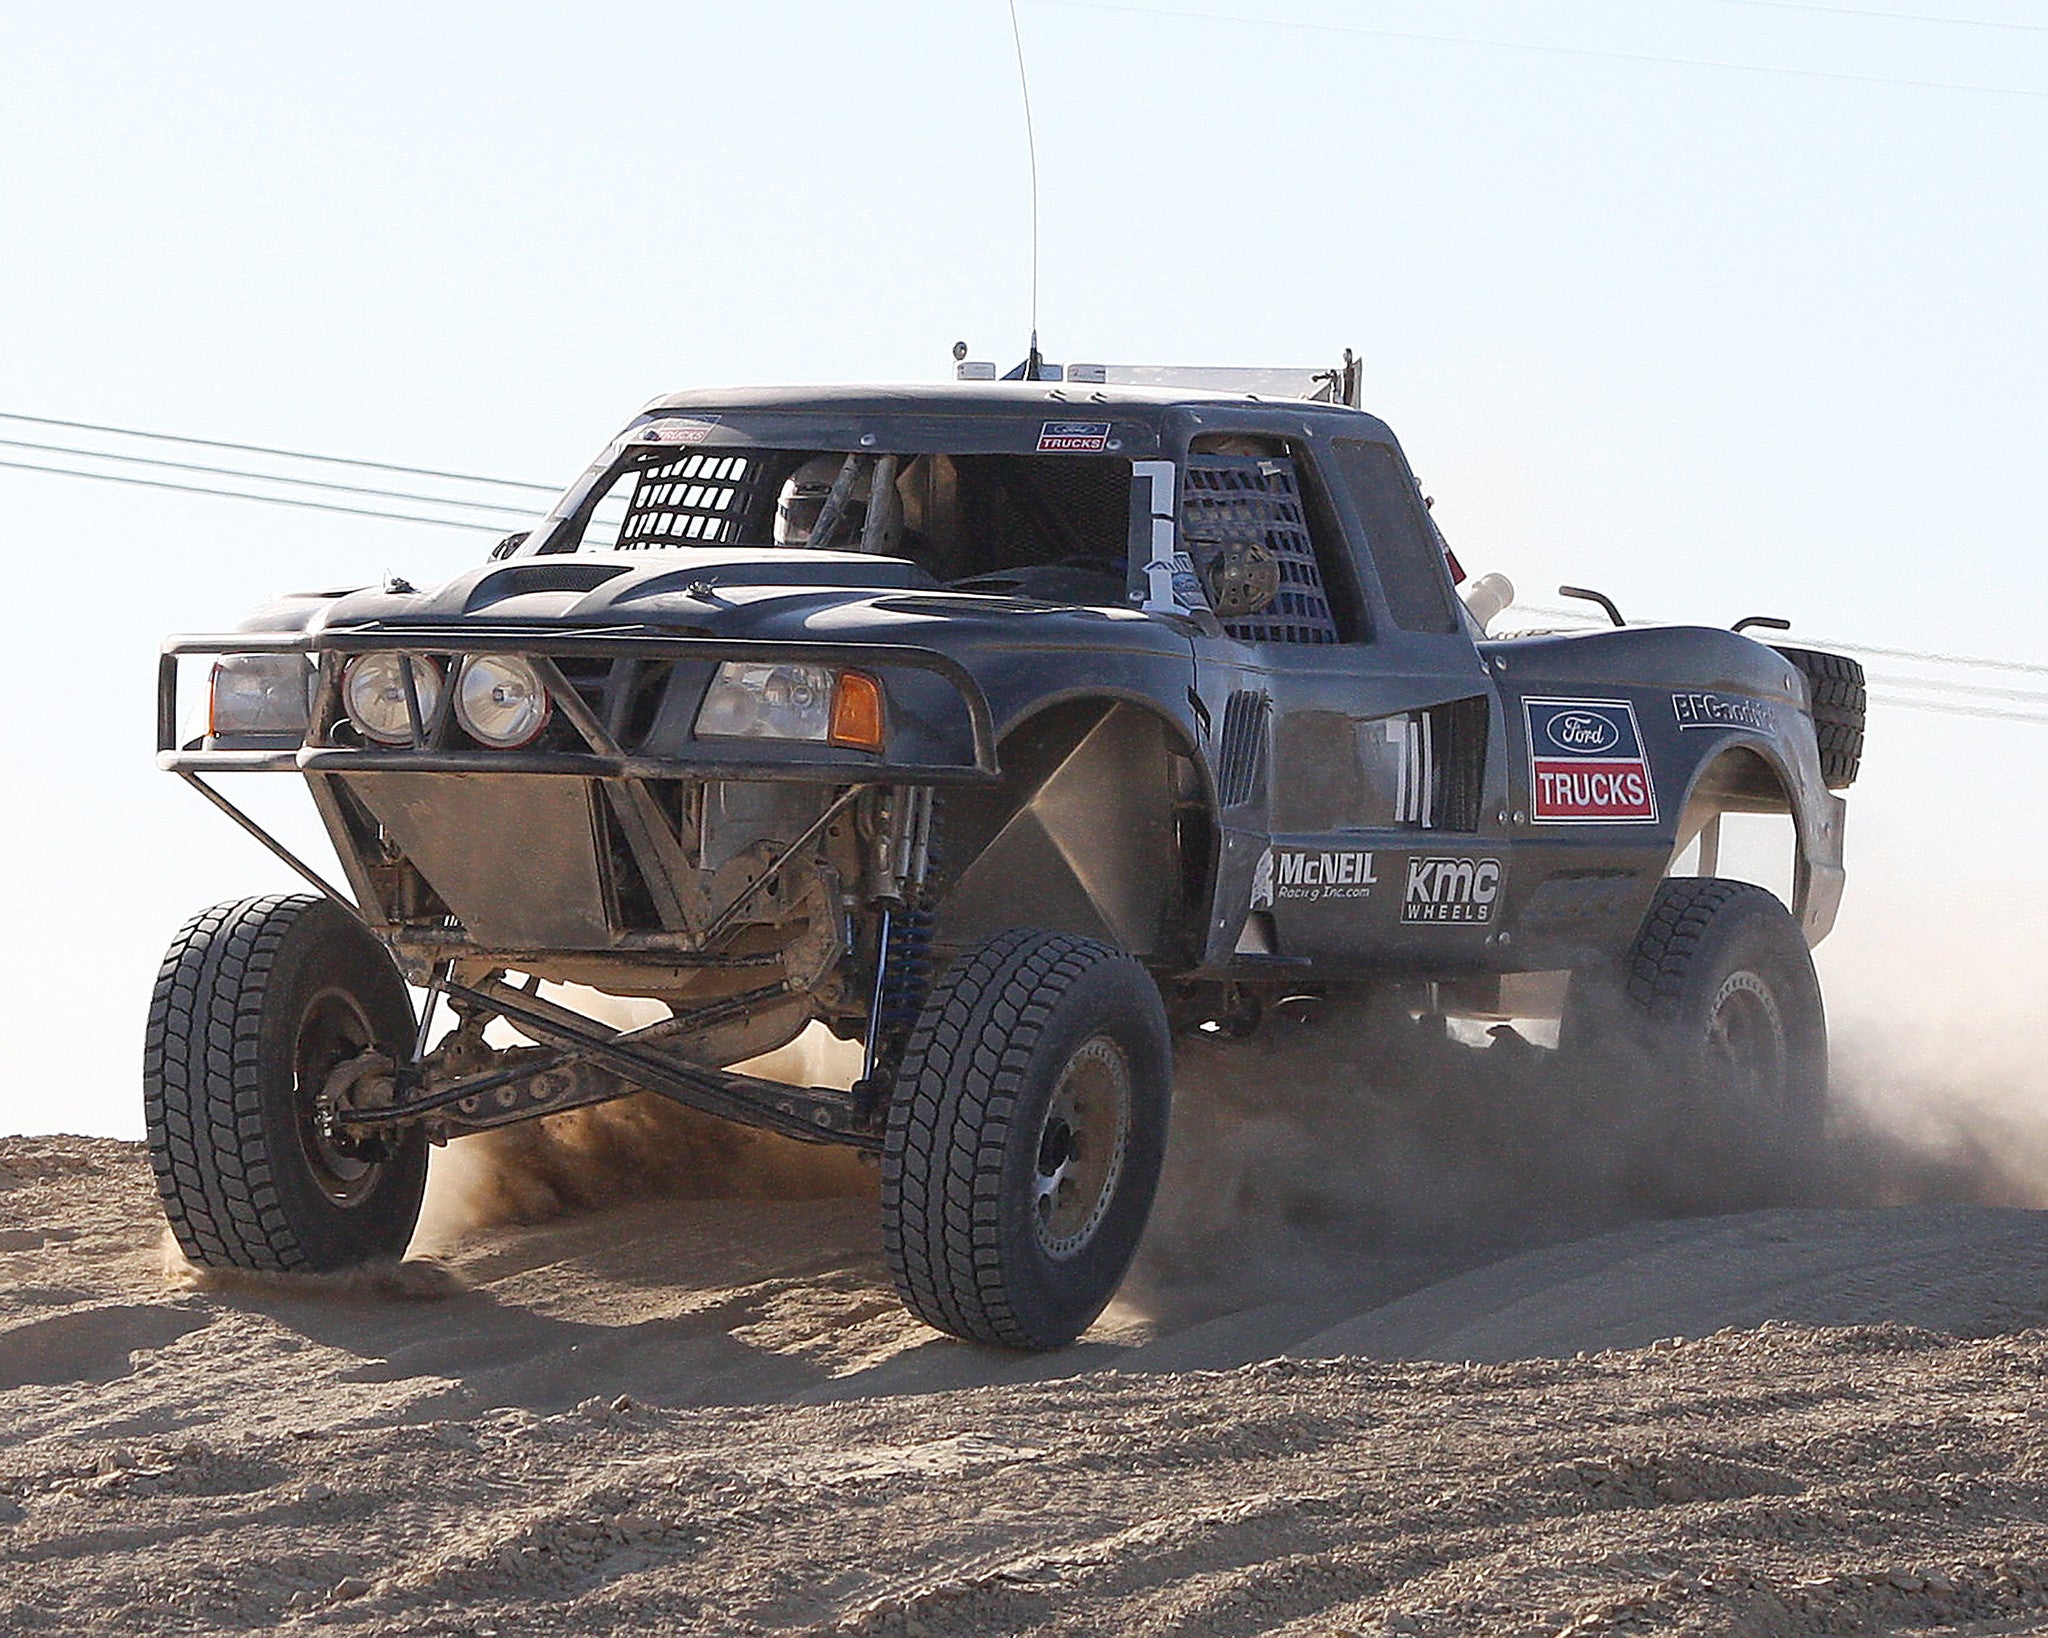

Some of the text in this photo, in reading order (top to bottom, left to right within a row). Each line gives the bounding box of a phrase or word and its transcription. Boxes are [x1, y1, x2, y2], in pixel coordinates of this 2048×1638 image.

[1043, 438, 1101, 449] TRUCKS
[1561, 716, 1605, 744] Ford
[1539, 773, 1646, 807] TRUCKS
[1407, 904, 1489, 920] WHEELS
